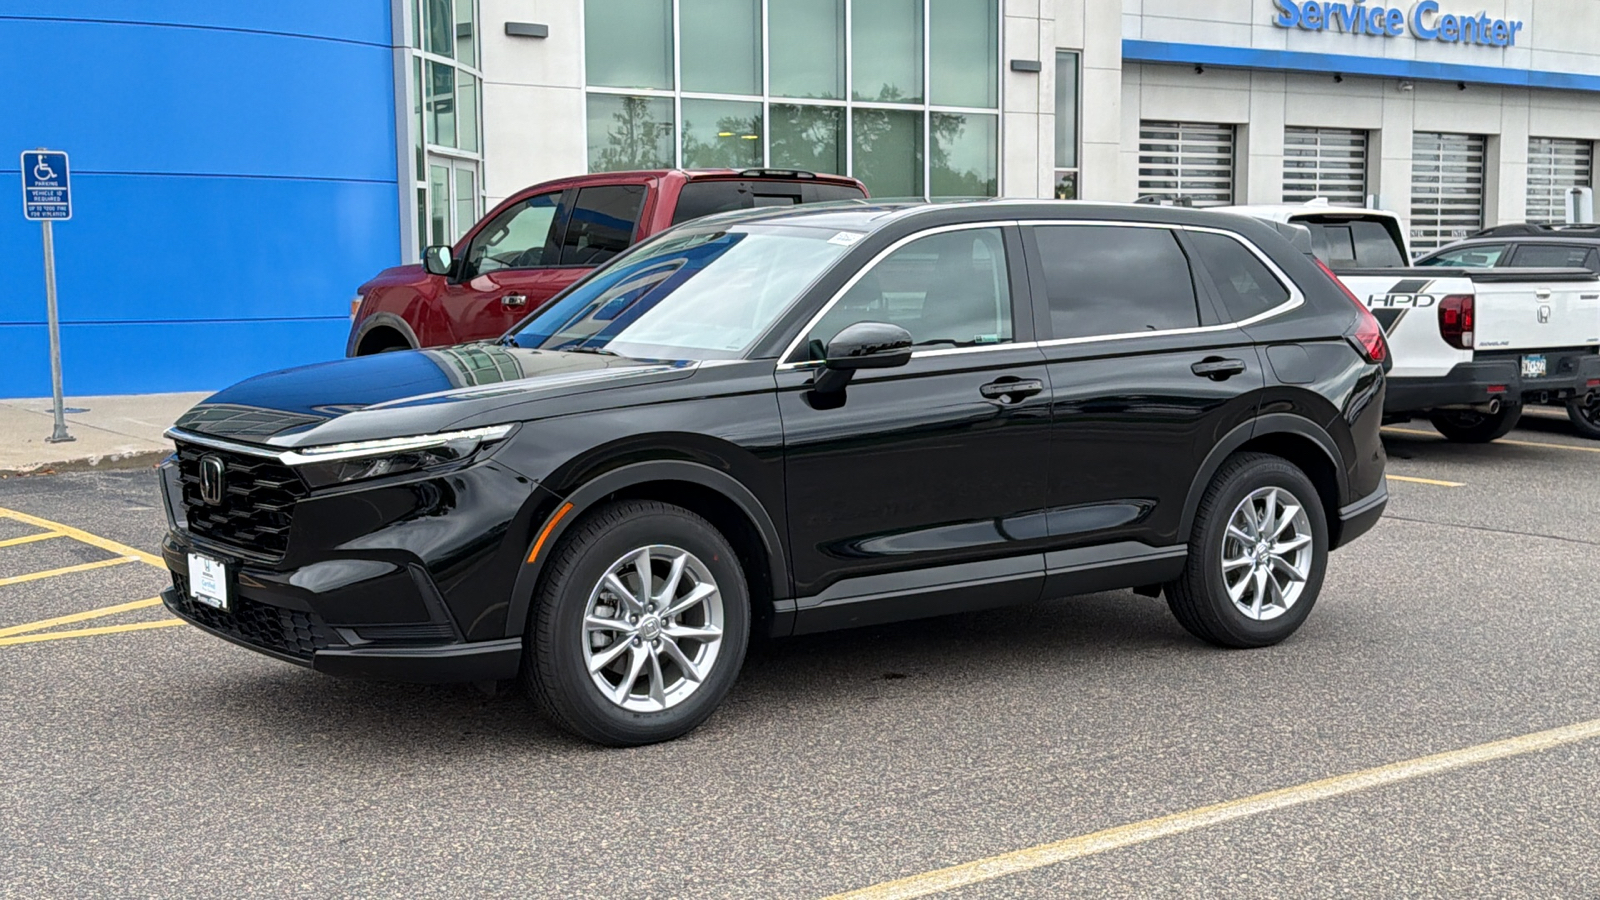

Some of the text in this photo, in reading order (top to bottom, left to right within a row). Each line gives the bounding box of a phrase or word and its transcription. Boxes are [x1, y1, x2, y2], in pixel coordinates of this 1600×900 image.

[1274, 0, 1523, 46] Service Center
[1367, 294, 1435, 308] HPD
